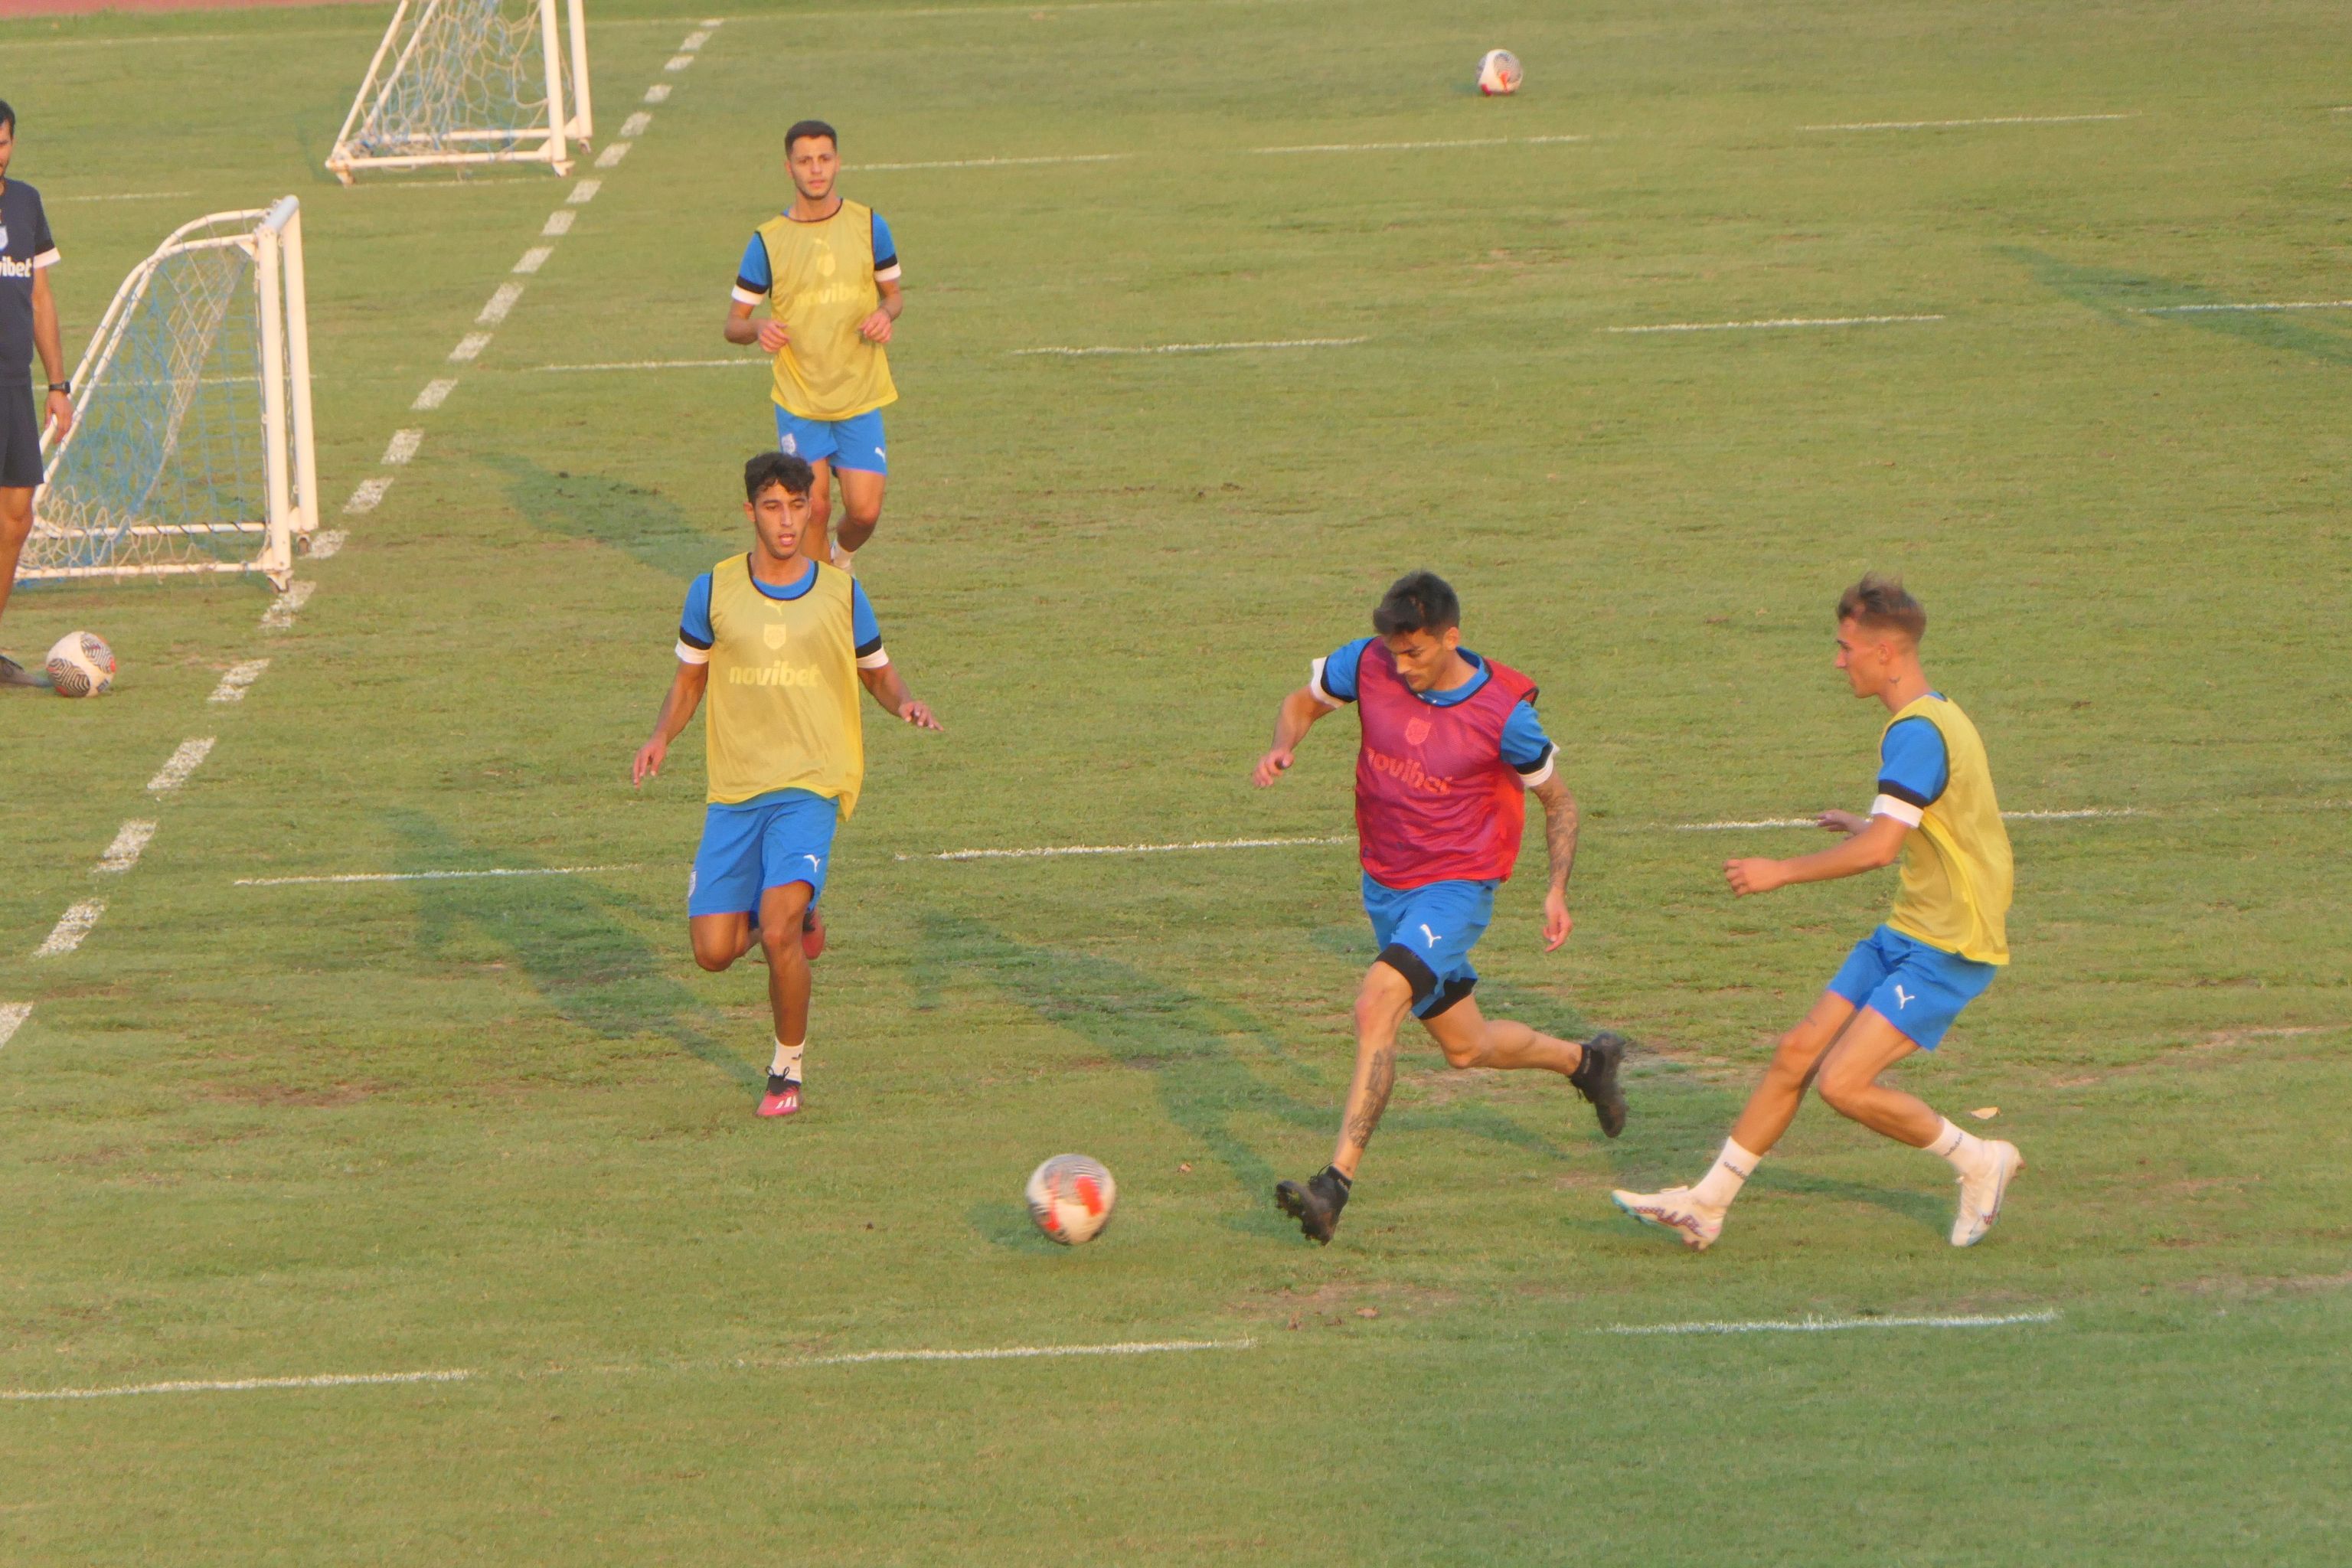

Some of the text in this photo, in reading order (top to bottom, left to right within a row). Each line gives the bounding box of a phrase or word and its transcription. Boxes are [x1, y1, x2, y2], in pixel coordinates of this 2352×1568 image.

[0, 256, 32, 277] ibet
[795, 282, 867, 305] novib
[729, 660, 820, 688] novibet
[1723, 1161, 1747, 1181] adida
